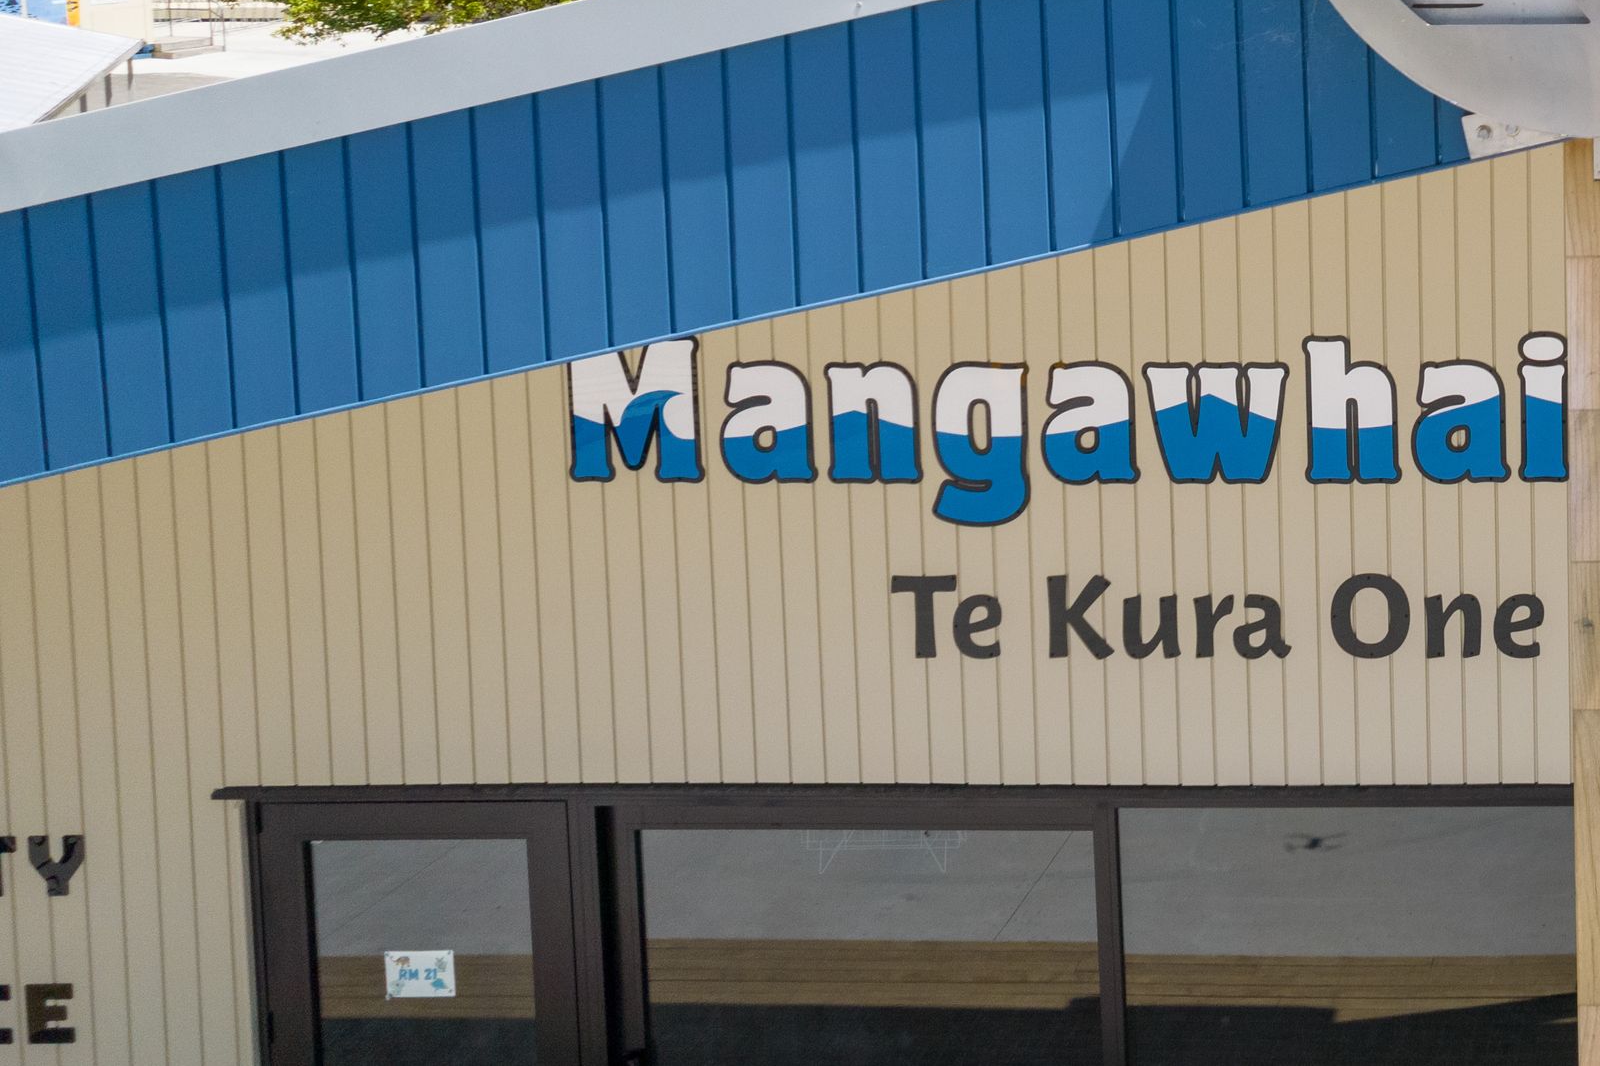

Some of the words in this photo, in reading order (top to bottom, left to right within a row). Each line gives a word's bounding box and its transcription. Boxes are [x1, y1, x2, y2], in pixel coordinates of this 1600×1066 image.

[569, 331, 1569, 527] Mangawhai
[890, 574, 1003, 659] Te
[1046, 574, 1292, 660] Kura
[1330, 573, 1545, 659] One
[399, 968, 419, 981] RM
[424, 968, 437, 981] 21
